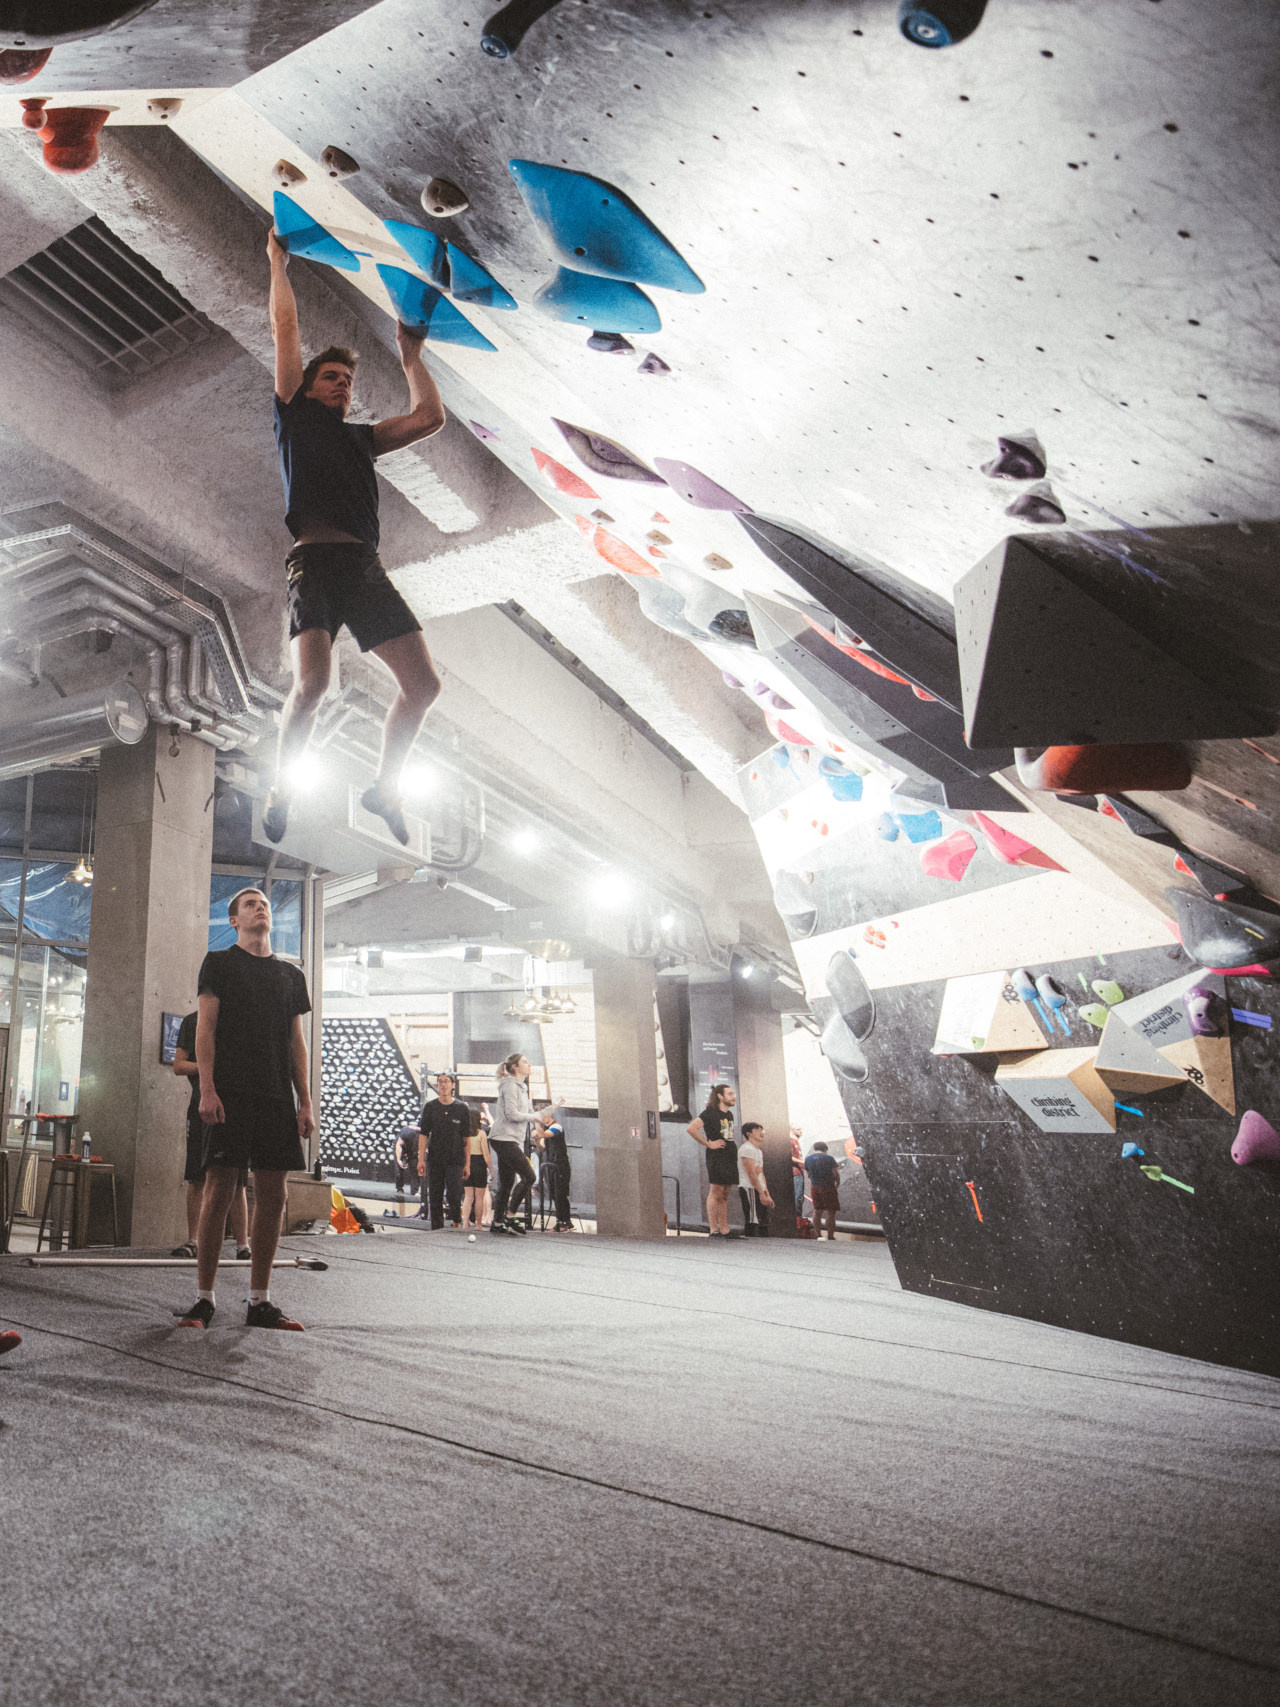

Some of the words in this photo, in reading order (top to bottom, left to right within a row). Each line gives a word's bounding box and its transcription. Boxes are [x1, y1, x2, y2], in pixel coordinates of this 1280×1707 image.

[1139, 1005, 1173, 1028] district
[1143, 1011, 1183, 1038] climbing
[1030, 1096, 1076, 1107] climbing
[1041, 1106, 1081, 1117] district
